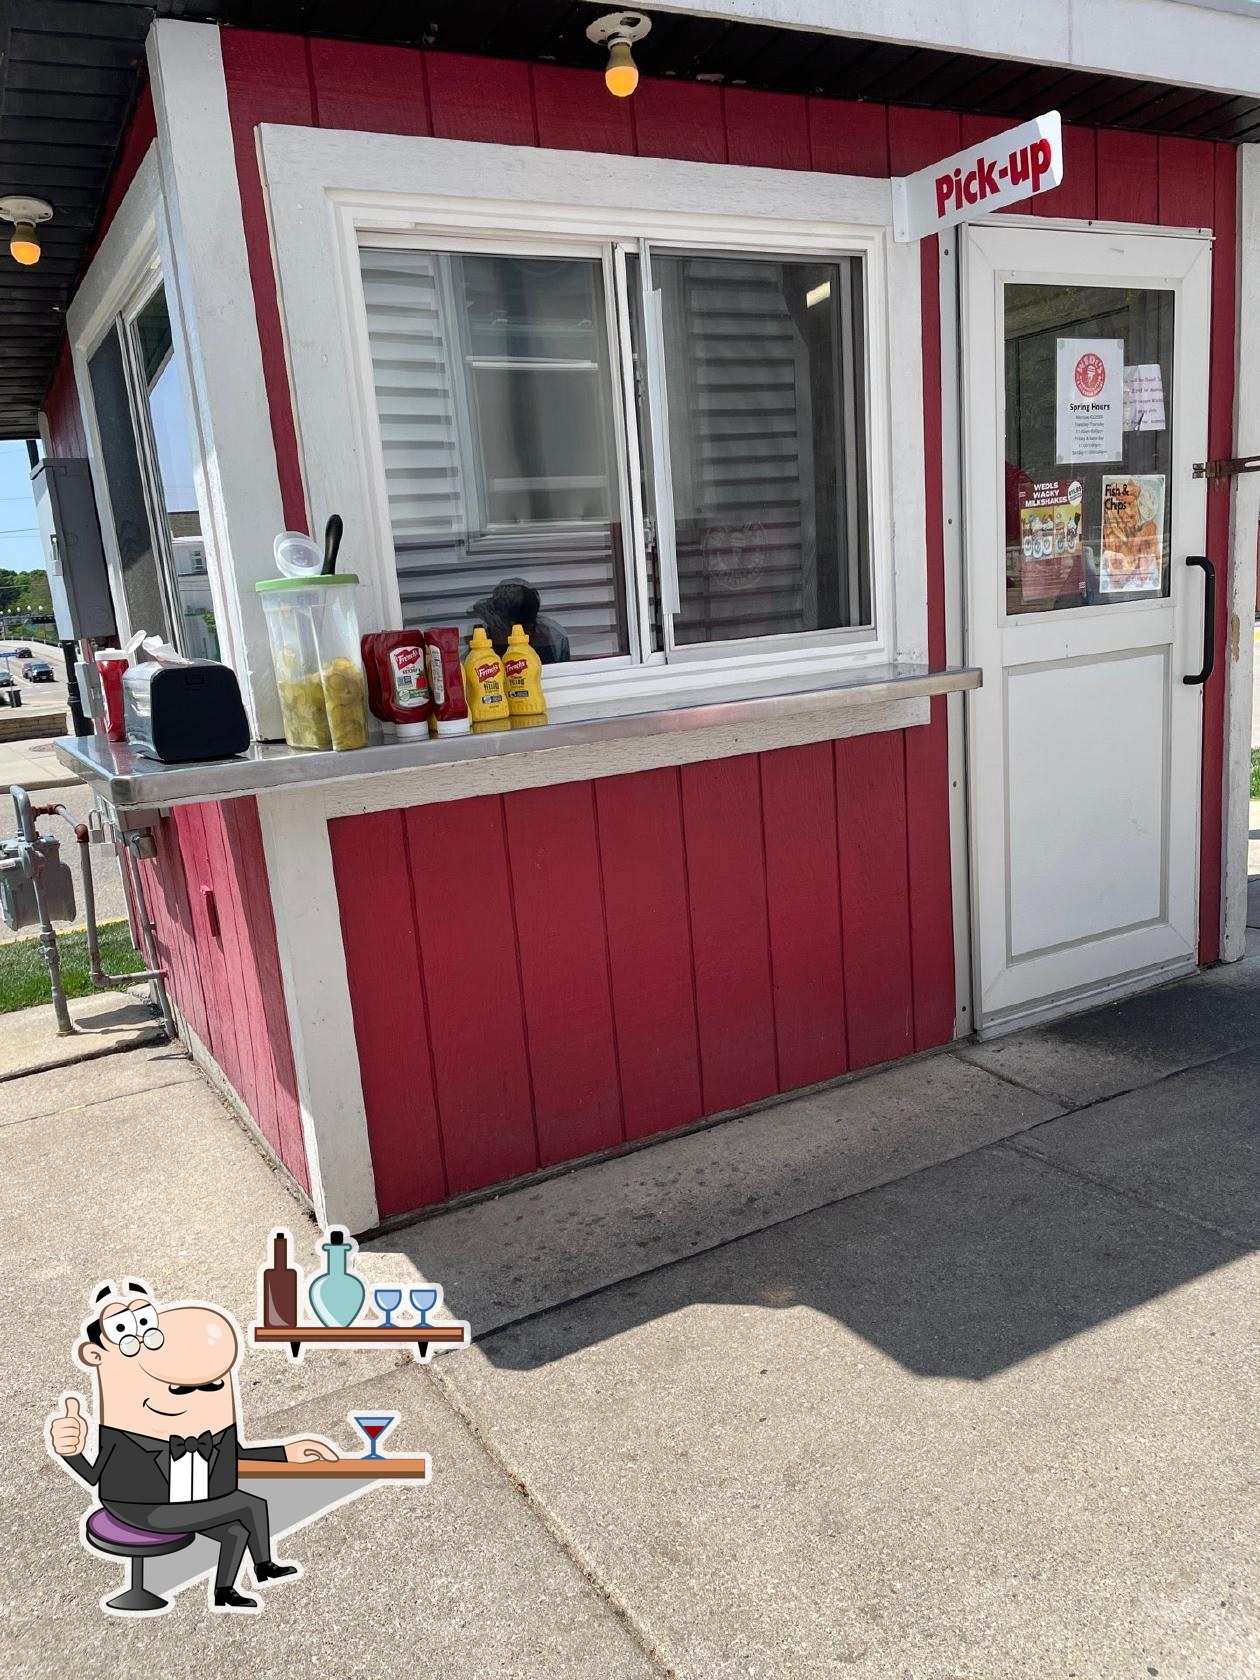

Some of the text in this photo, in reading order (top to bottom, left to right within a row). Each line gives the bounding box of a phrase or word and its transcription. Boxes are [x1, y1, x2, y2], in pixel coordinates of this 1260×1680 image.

[935, 138, 1052, 218] Pick-up
[1069, 402, 1110, 412] Spring Hours
[1033, 482, 1059, 491] WEDLS
[1105, 483, 1129, 497] Fish &
[1032, 489, 1060, 499] WACKY
[1025, 497, 1068, 507] MILKSHAKES
[1104, 498, 1127, 514] Chips
